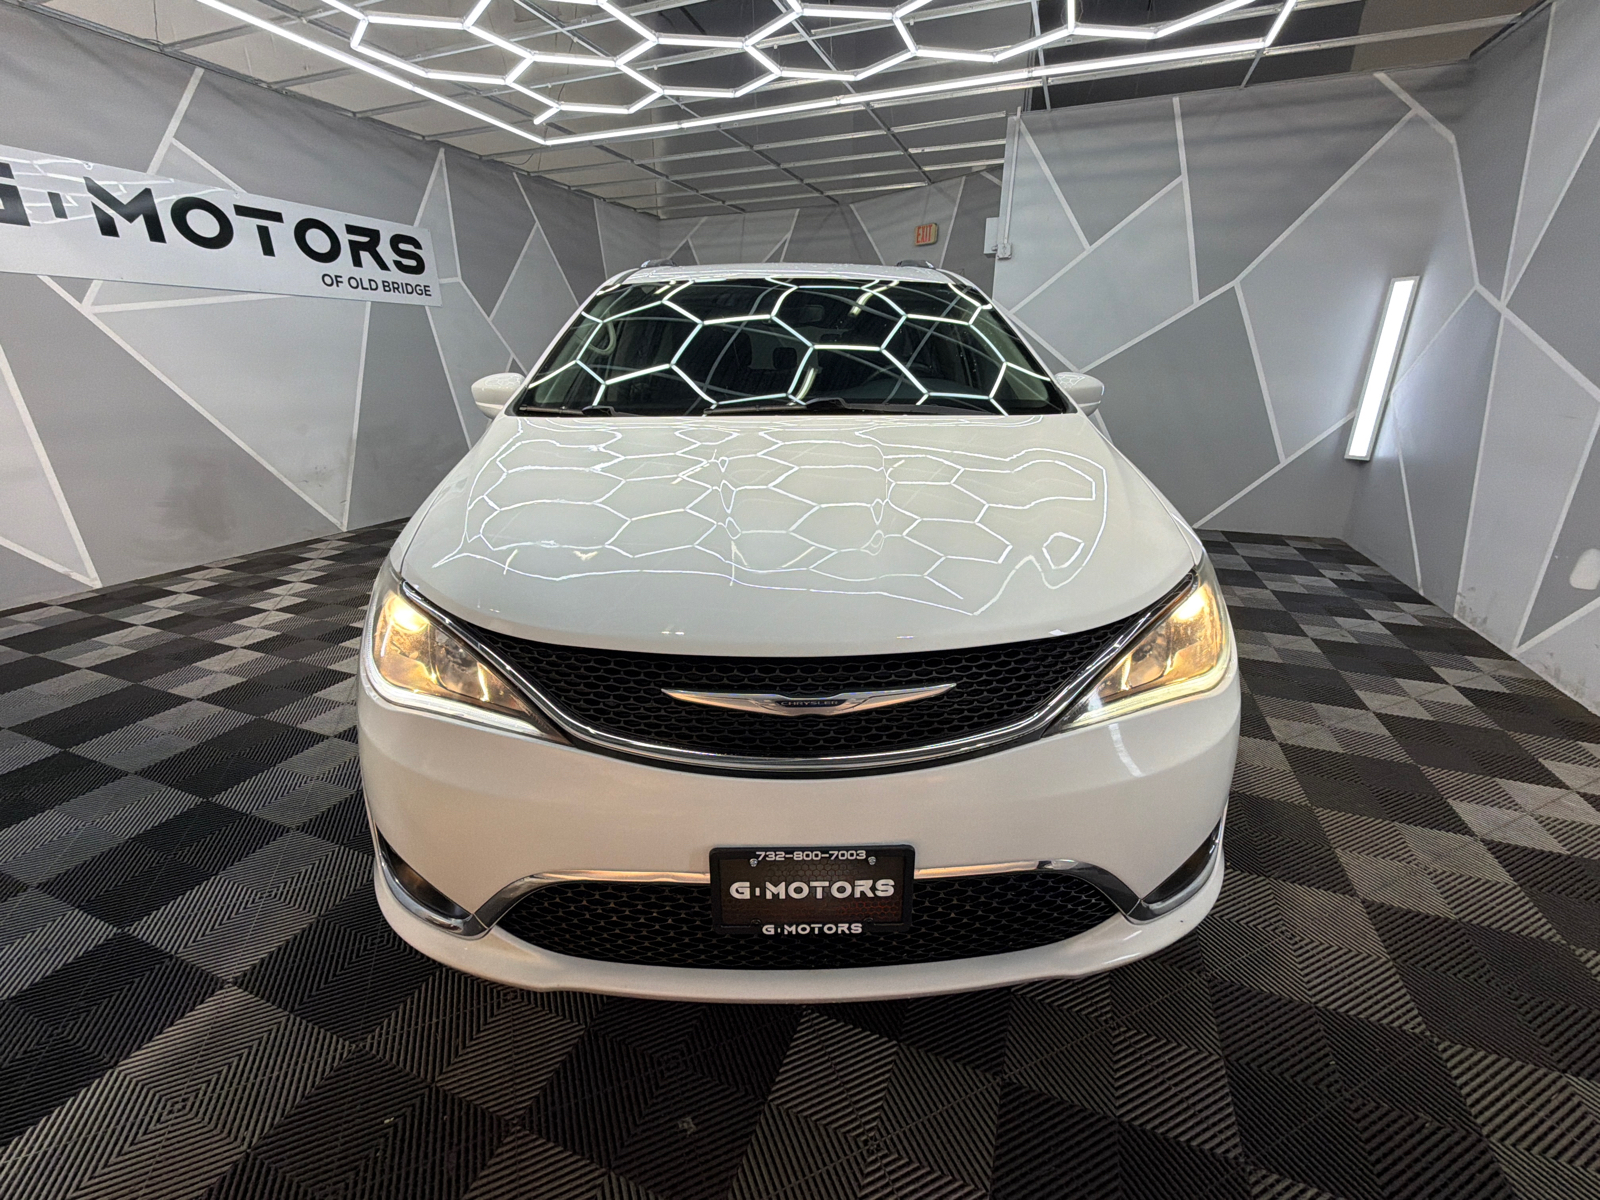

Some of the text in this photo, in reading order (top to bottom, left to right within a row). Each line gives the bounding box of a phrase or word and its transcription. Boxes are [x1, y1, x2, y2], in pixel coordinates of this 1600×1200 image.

[916, 223, 933, 244] EXIT
[321, 273, 432, 297] OF OLD BRIDGE
[755, 850, 867, 861] 732-800-7003
